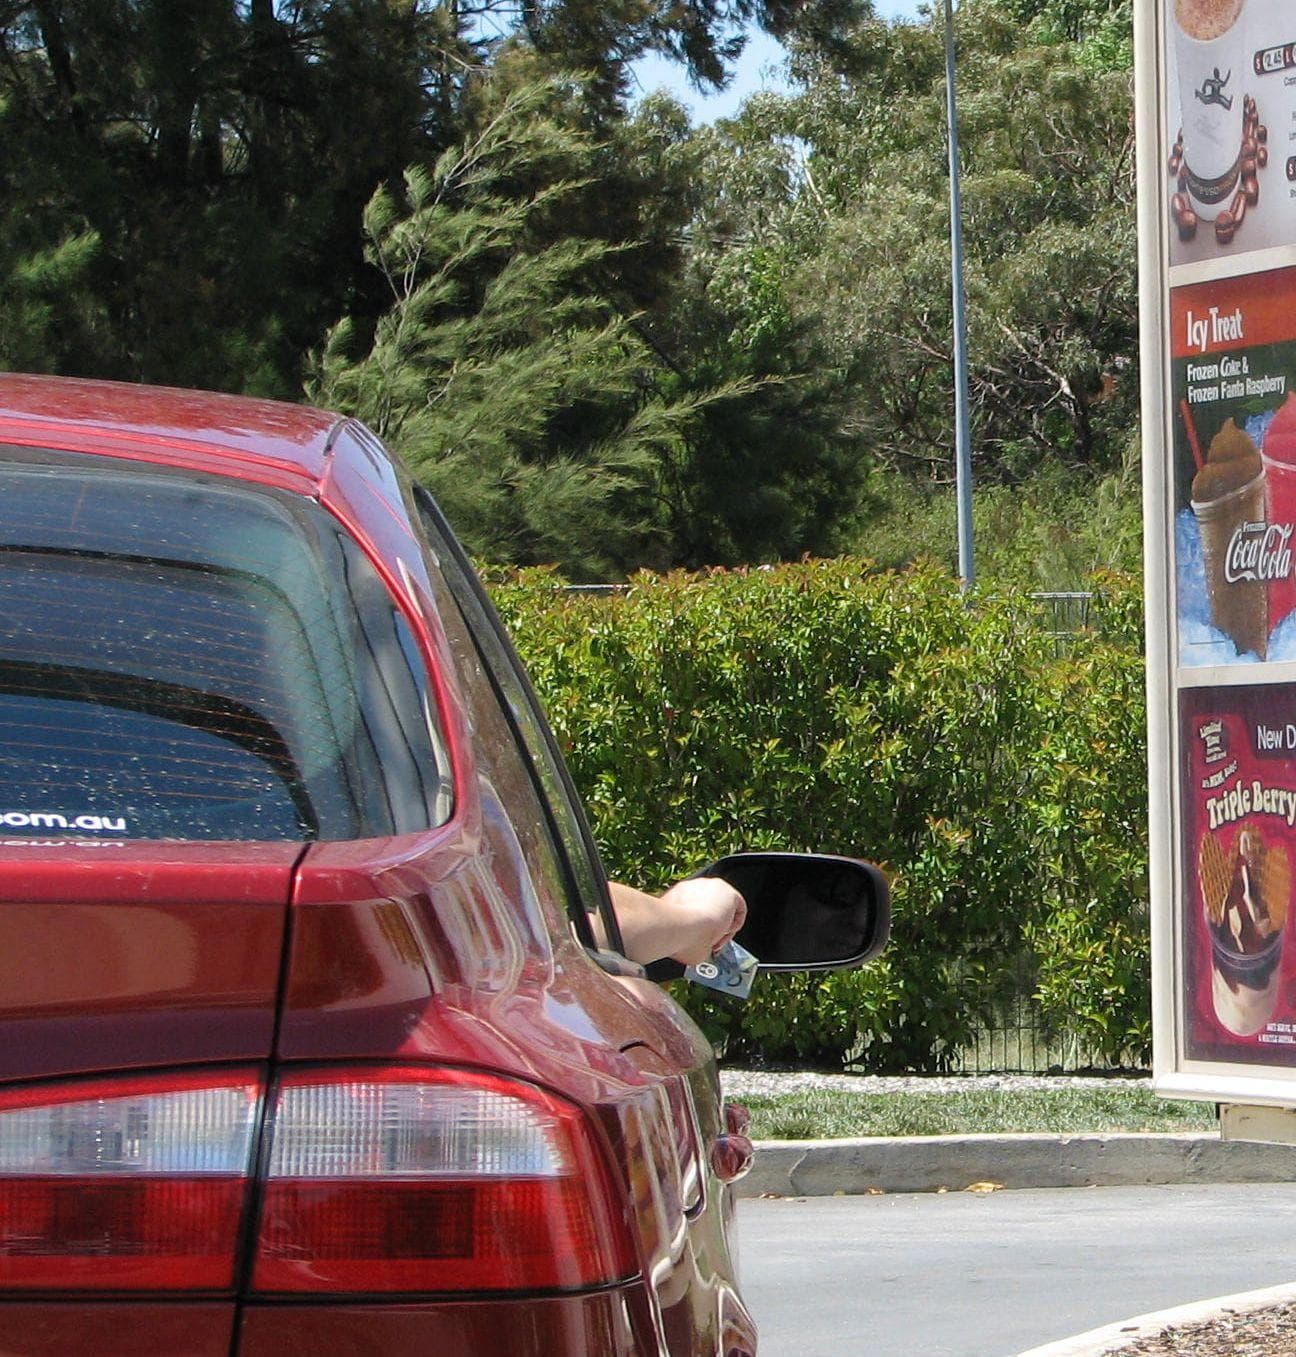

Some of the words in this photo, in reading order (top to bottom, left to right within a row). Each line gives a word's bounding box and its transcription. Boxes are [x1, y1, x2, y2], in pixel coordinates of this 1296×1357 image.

[1186, 310, 1209, 352] Icy
[1209, 307, 1243, 343] Treat
[1187, 363, 1219, 382] Frozen
[1242, 356, 1249, 374] &
[1188, 385, 1219, 404] Frozen
[1220, 379, 1245, 400] Fanta
[1246, 374, 1286, 397] Raspberry
[1257, 725, 1283, 750] New
[1206, 780, 1251, 830] Triple
[1252, 780, 1296, 827] Berry
[0, 812, 126, 831] om.au
